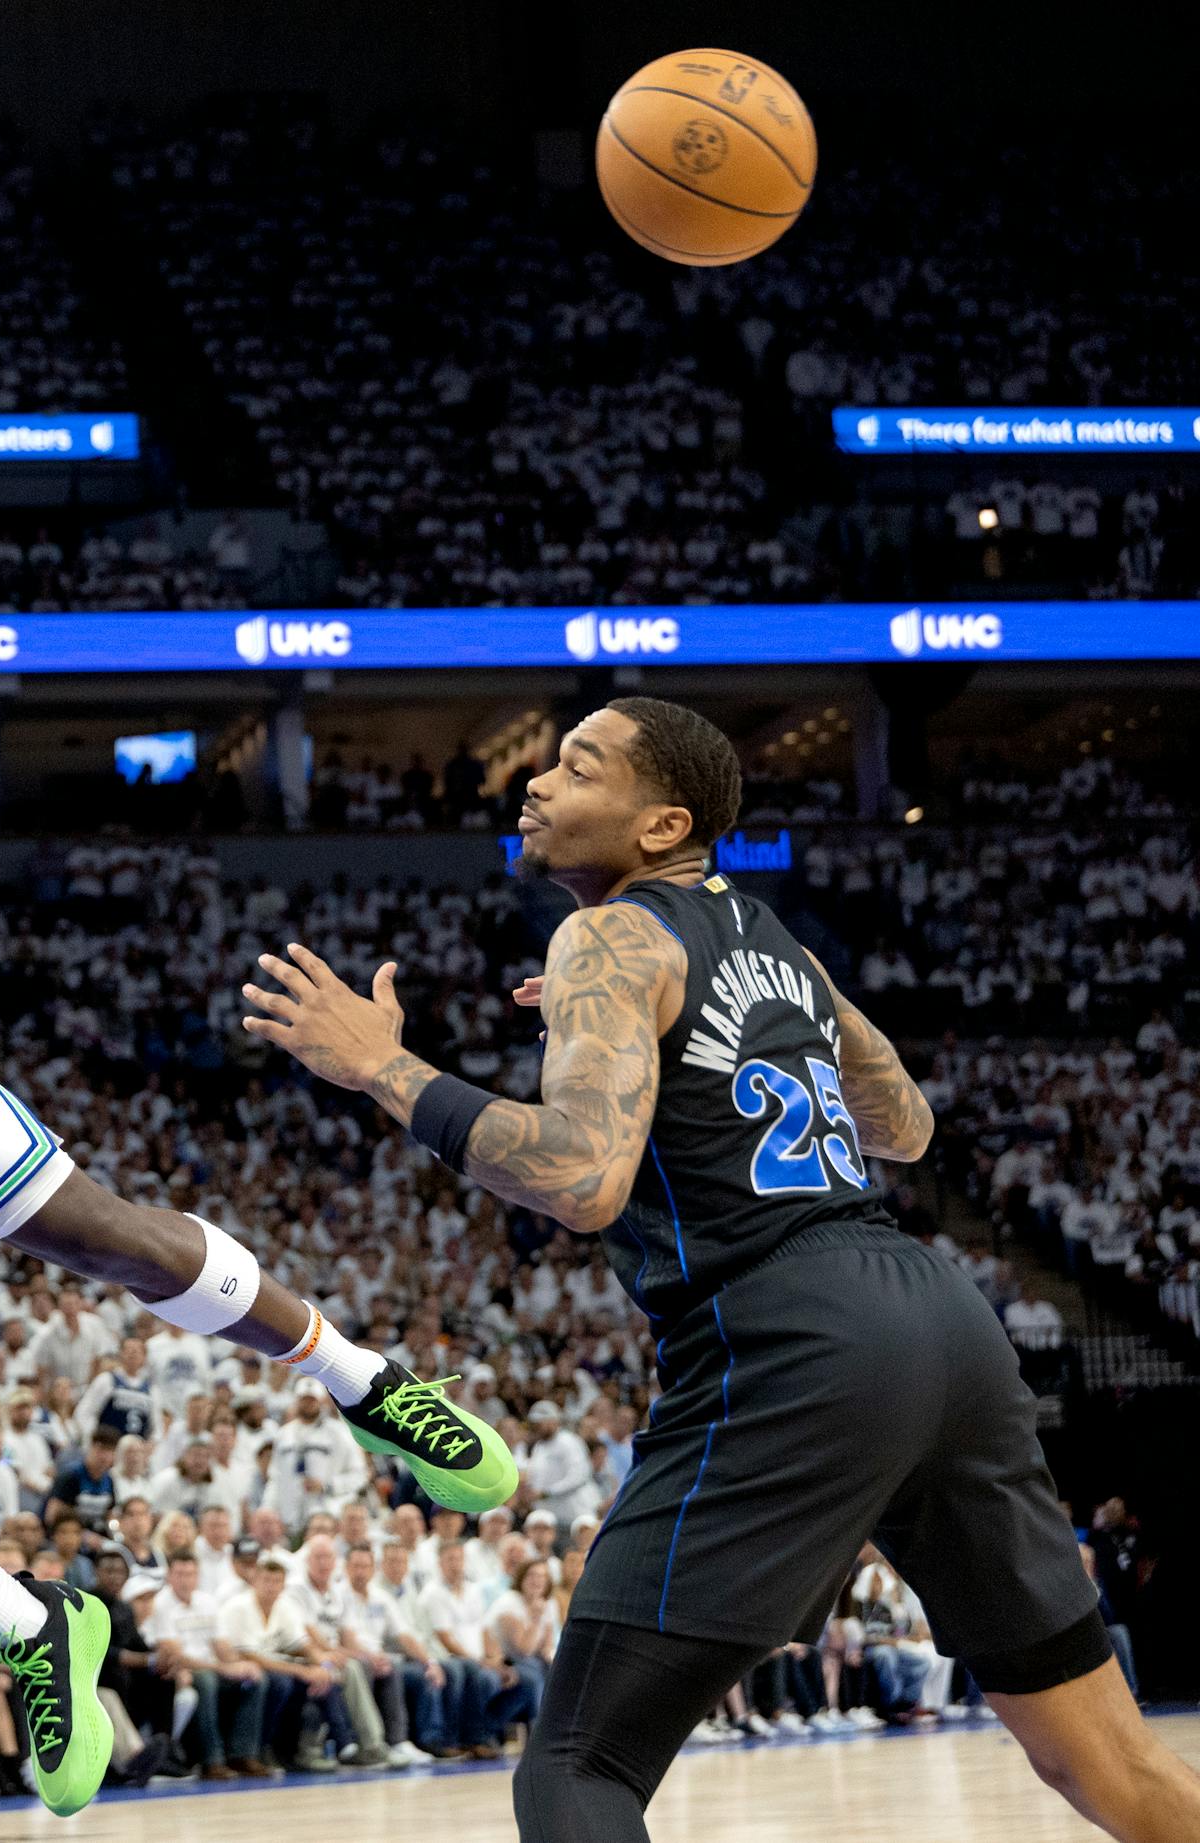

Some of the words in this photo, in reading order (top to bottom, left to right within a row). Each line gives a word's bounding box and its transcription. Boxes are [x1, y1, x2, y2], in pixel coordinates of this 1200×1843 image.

[897, 417, 971, 444] There
[972, 416, 1009, 444] for
[1011, 417, 1073, 444] what
[1076, 418, 1174, 444] matters
[269, 620, 352, 658] UHC
[596, 617, 680, 654] UHC
[922, 613, 1002, 650] UHC
[680, 949, 816, 1075] WASHINGTON
[731, 1057, 870, 1196] 25
[219, 1275, 239, 1298] 5
